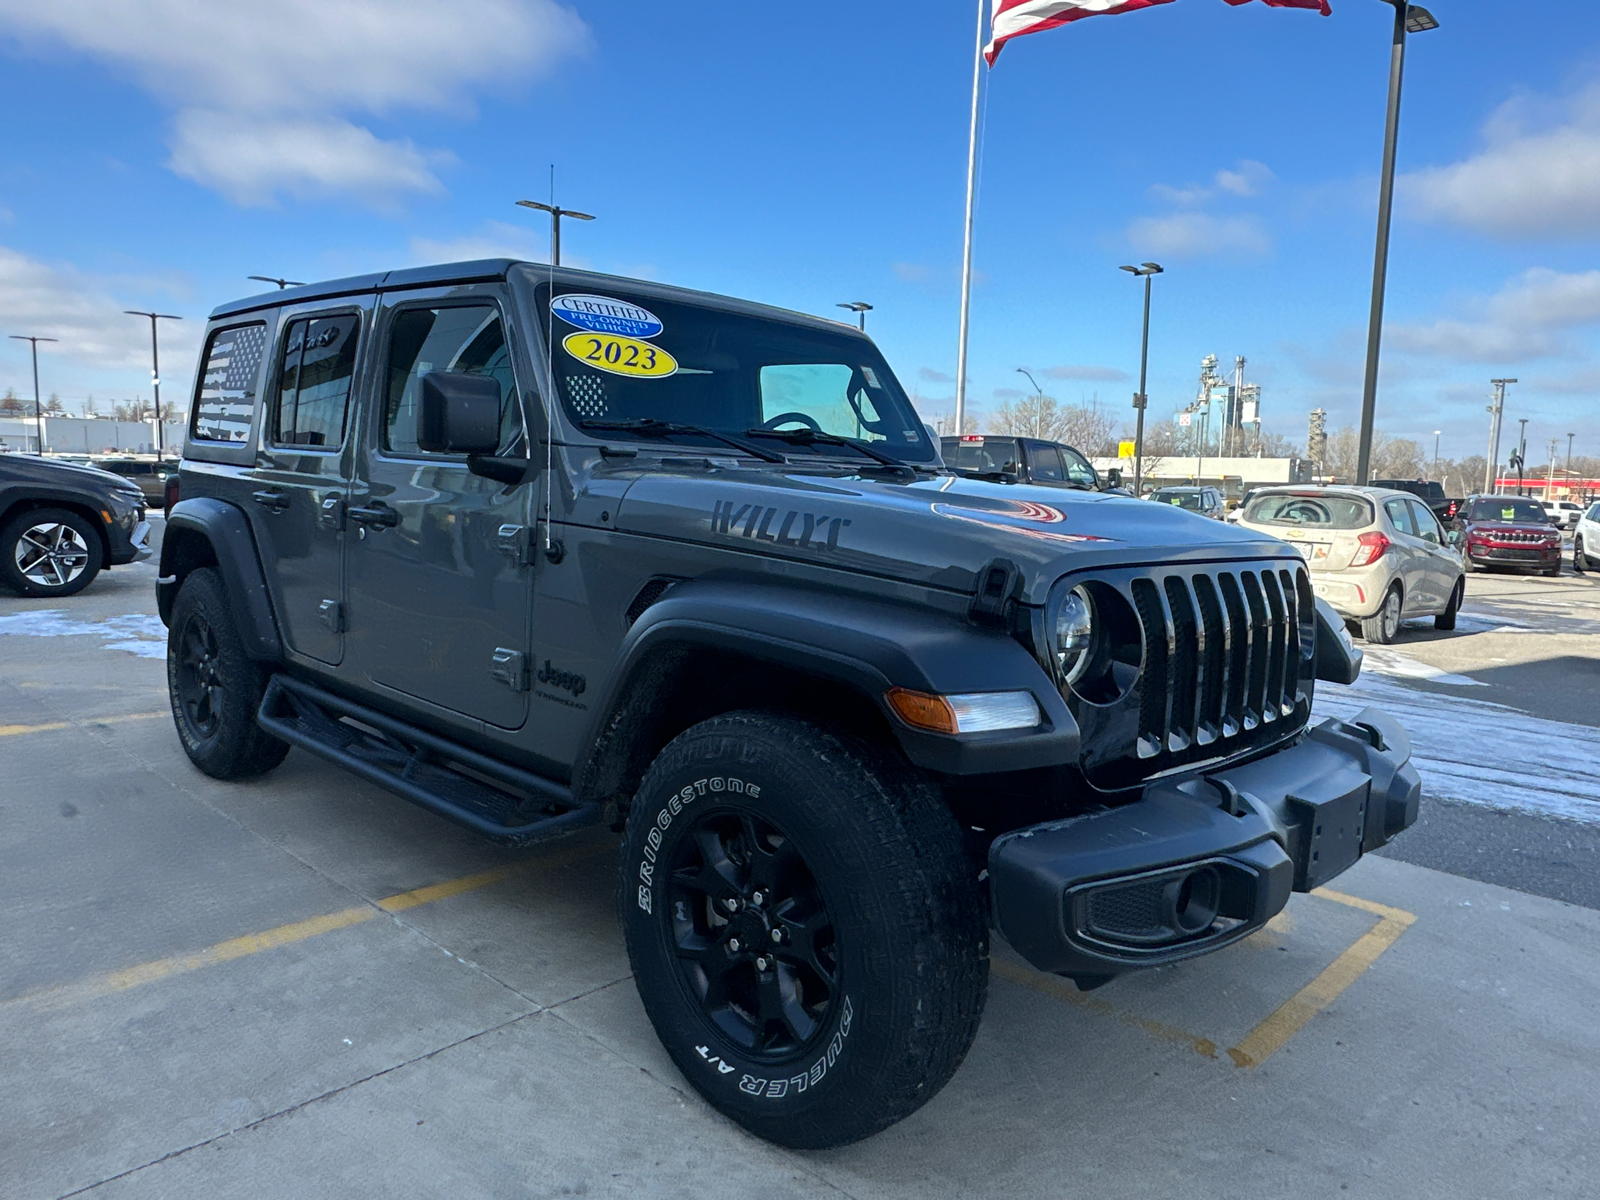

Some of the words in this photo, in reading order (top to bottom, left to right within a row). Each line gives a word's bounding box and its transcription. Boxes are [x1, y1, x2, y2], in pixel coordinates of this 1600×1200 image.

[561, 299, 648, 321] CERTIFIED
[571, 311, 648, 329] PRE-OWNED
[585, 321, 641, 335] VEHICLE
[585, 339, 657, 370] 2023
[538, 659, 586, 697] Jeep
[638, 777, 761, 914] BRIDGESTONE
[695, 1045, 735, 1074] A/T
[739, 995, 853, 1097] DUELER
